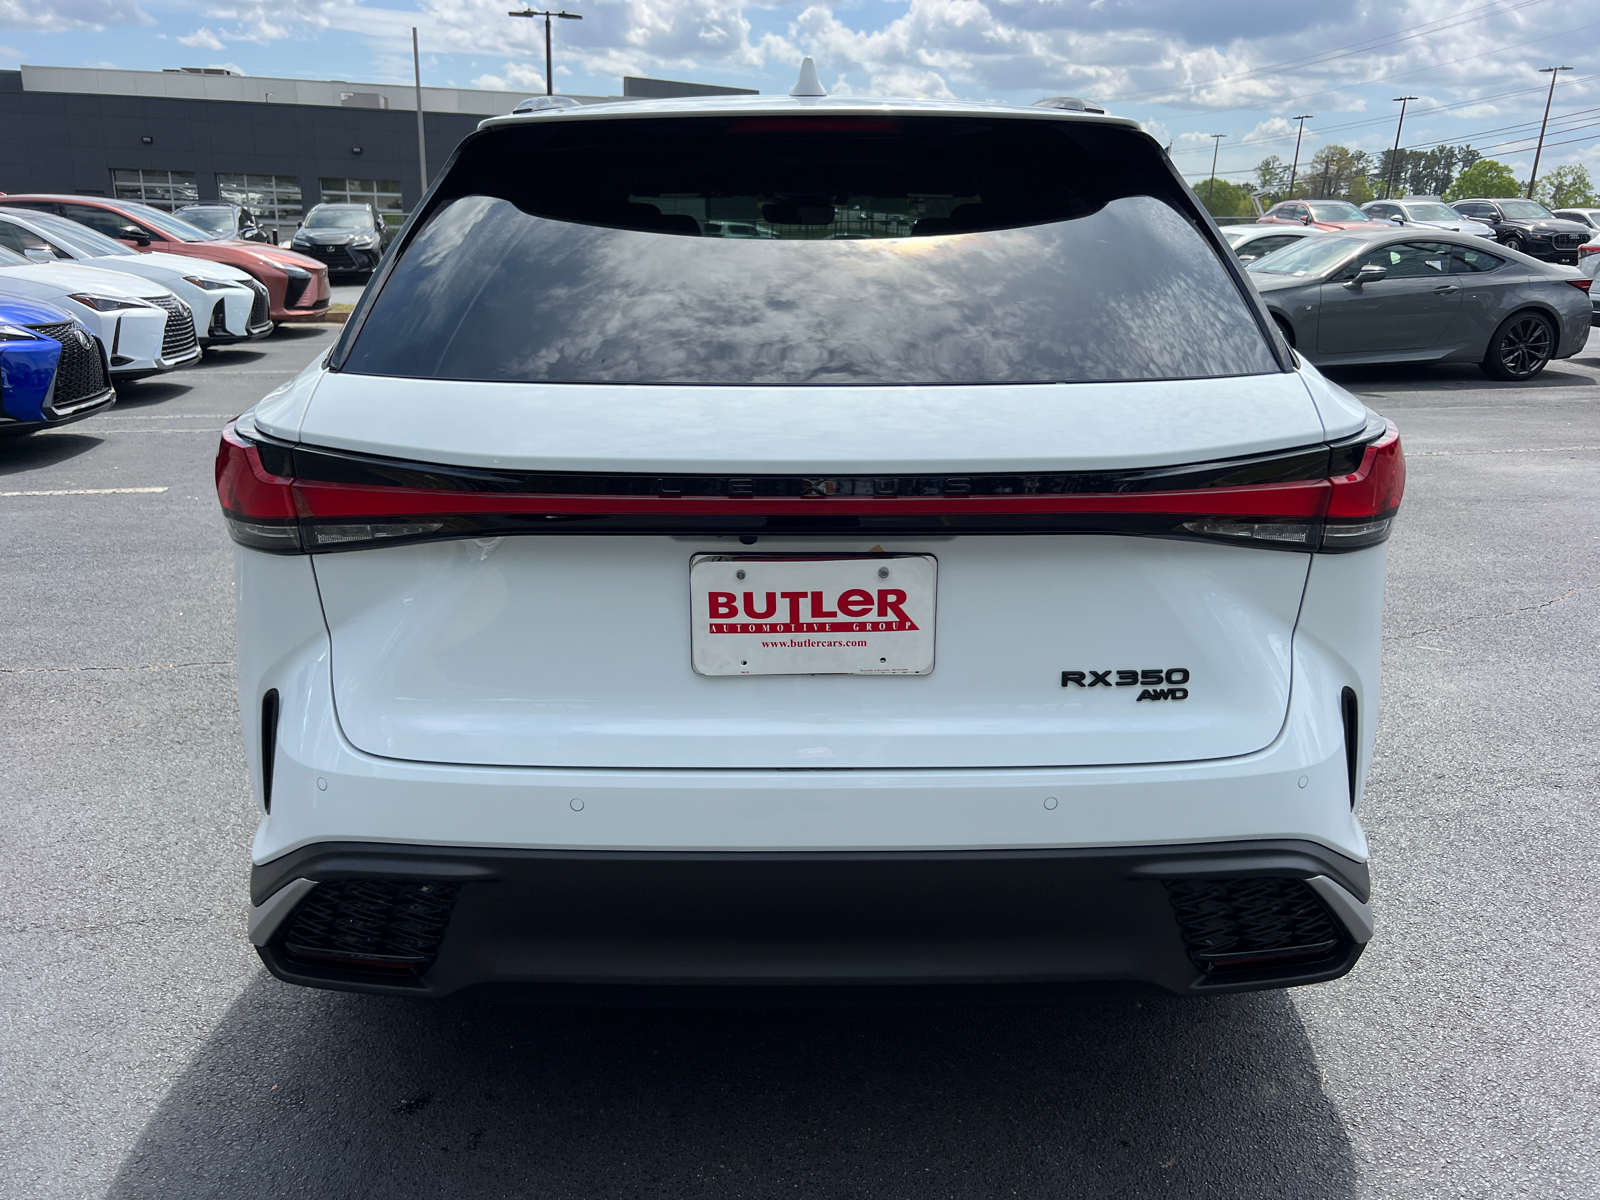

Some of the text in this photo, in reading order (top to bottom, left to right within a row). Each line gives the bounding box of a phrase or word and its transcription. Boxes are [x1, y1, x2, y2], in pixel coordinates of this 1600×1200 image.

[657, 478, 971, 496] LEXUS
[710, 621, 912, 633] AUTOMOTIVE GROUP
[761, 638, 868, 648] www.butlercars.com
[1136, 688, 1189, 702] AWD
